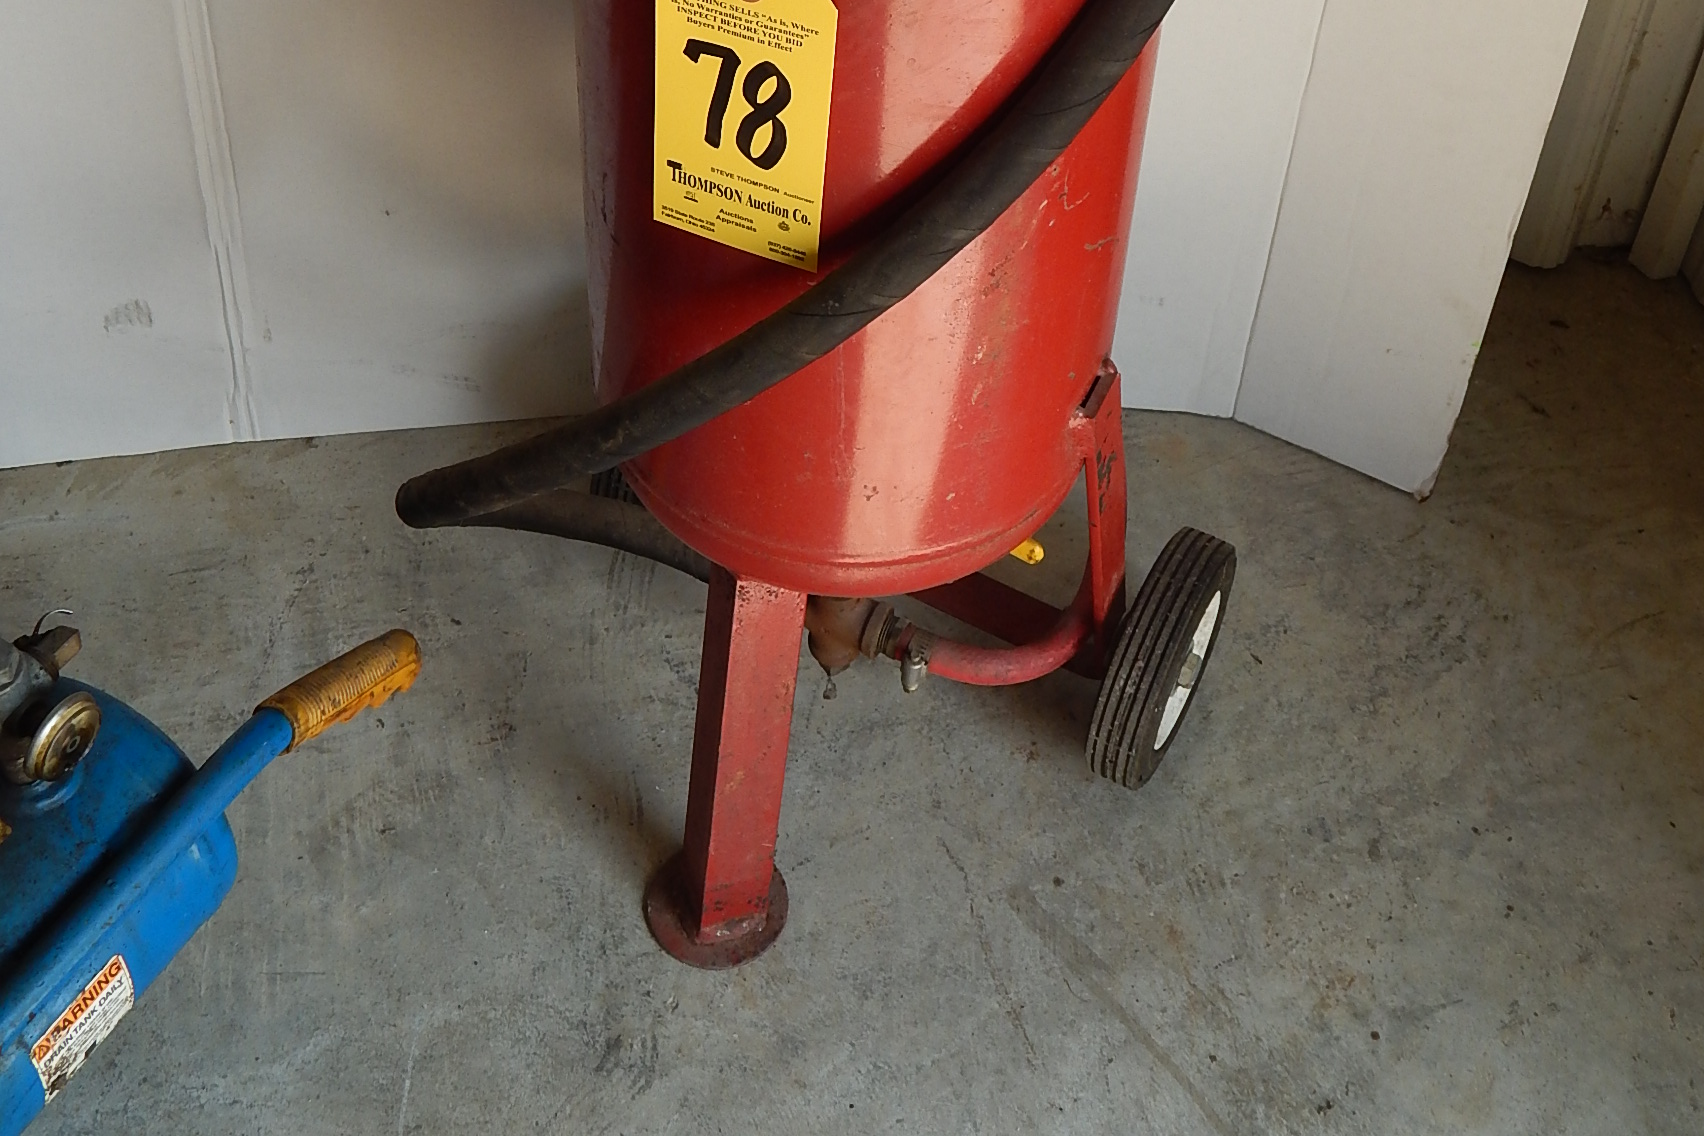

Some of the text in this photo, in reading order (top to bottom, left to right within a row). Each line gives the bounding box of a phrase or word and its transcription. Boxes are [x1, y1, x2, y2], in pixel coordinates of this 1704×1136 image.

[676, 5, 803, 48] INSPECT BEFORE YOU BID
[682, 0, 695, 7] No
[696, 2, 742, 22] Warranties
[728, 4, 760, 19] SELLS
[790, 21, 819, 35] Where
[686, 16, 793, 53] Buyers Premium in Effect
[682, 37, 792, 171] 78
[666, 159, 812, 226] THOMPSON Auction Co.
[710, 166, 735, 180] STEVE
[736, 175, 780, 194] THOMPSON
[715, 214, 757, 233] Appraisals
[718, 208, 754, 224] Auctions
[47, 961, 122, 1044] ARNING
[43, 976, 124, 1069] DRAIN TANK DAILY
